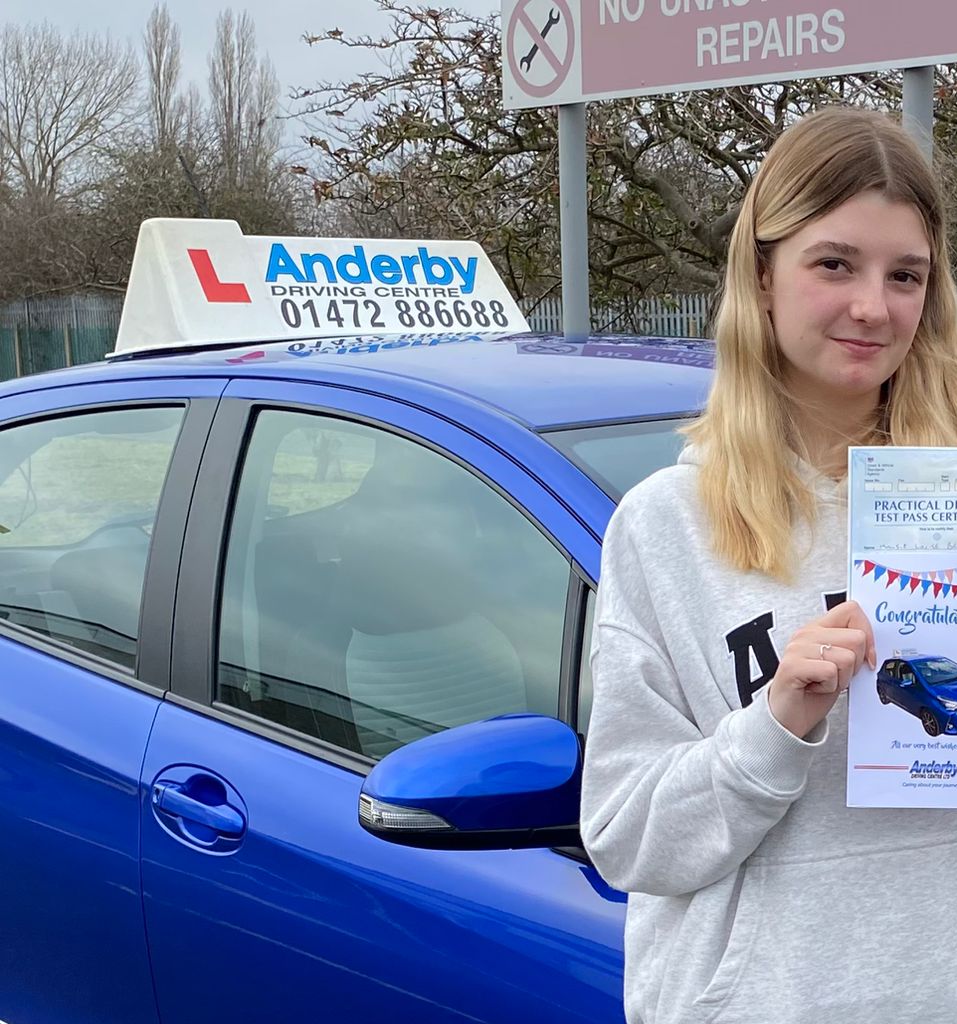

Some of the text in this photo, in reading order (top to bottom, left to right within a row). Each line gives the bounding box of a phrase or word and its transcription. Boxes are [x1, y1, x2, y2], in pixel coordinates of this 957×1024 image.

[696, 9, 845, 68] REPAIRS
[265, 242, 478, 294] Anderby
[270, 284, 460, 299] DRIVING CENTRE
[280, 298, 509, 329] 01472 886688
[874, 499, 941, 511] PRACTICAL
[875, 512, 898, 523] TEST
[902, 512, 928, 522] PASS
[913, 742, 926, 751] very
[927, 741, 940, 750] best
